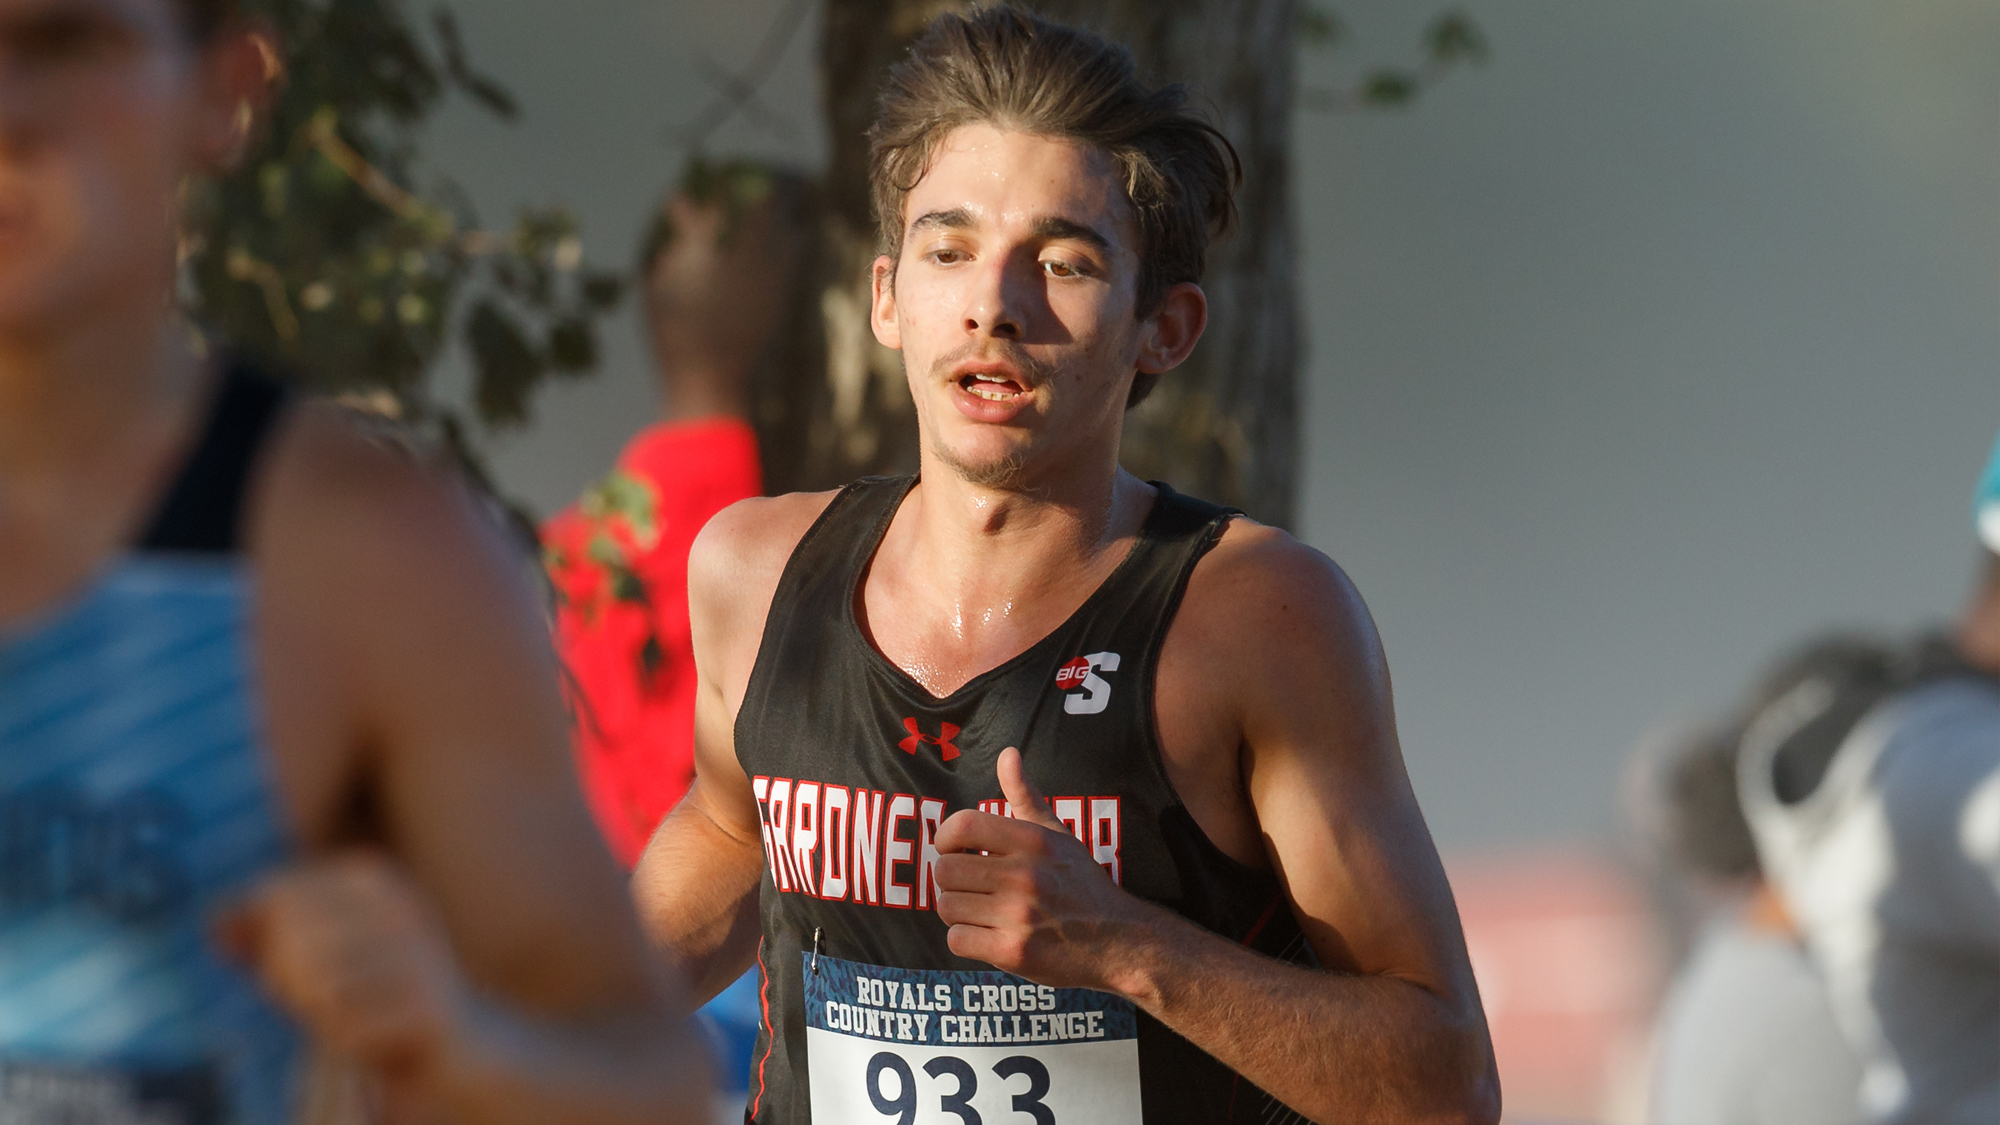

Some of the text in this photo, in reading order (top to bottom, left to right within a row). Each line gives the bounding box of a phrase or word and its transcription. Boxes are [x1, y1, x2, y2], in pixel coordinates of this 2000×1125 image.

[1056, 652, 1121, 715] BIG S
[752, 775, 947, 911] GARDNER
[826, 1000, 1105, 1043] COUNTRY CHALLENGE
[856, 976, 1056, 1013] ROYALS CROSS
[866, 1051, 1057, 1125] 933
